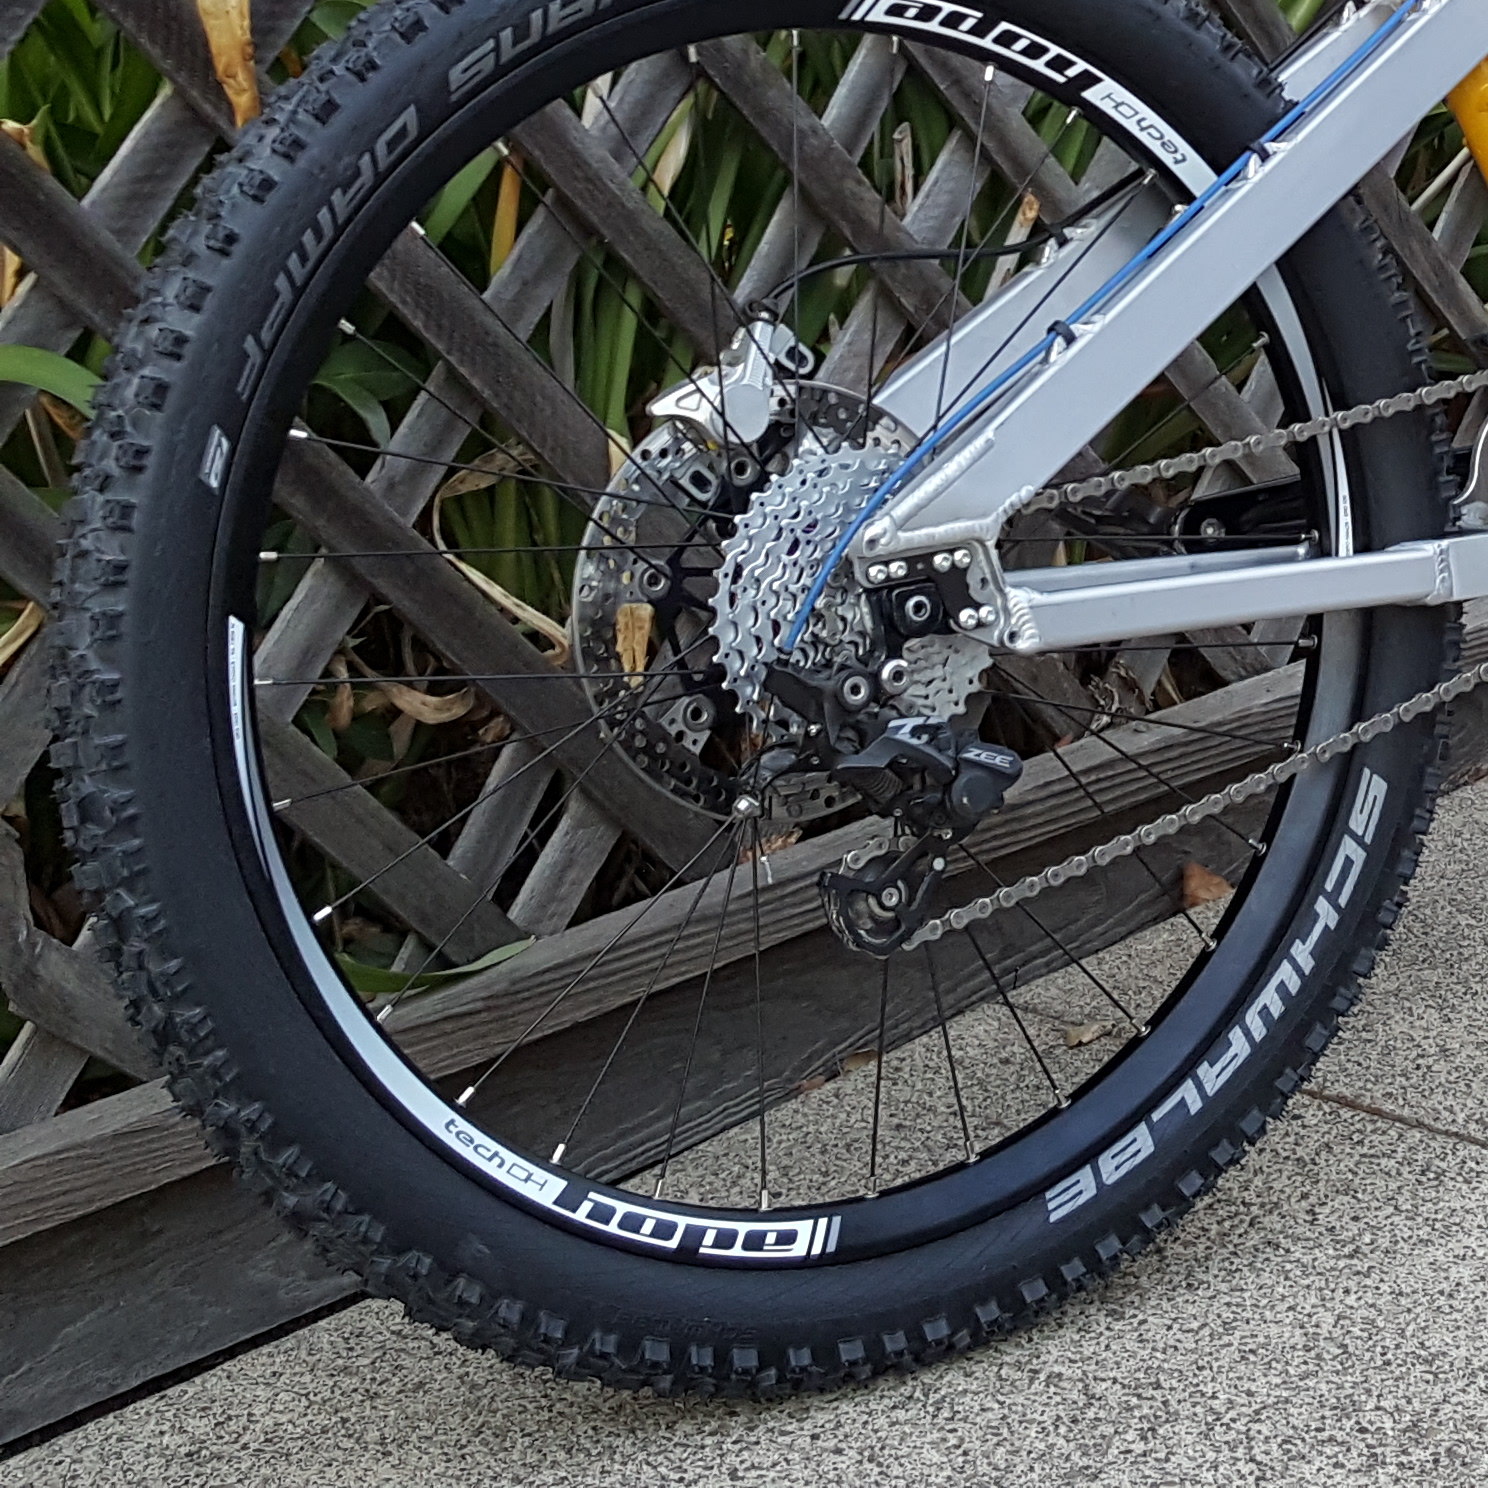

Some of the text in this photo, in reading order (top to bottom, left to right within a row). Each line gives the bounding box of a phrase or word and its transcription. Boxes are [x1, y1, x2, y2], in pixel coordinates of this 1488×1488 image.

[236, 104, 421, 402] DAMPF
[960, 747, 1015, 768] ZEE
[1044, 767, 1388, 1223] SCHWALBE
[553, 1176, 814, 1260] hope
